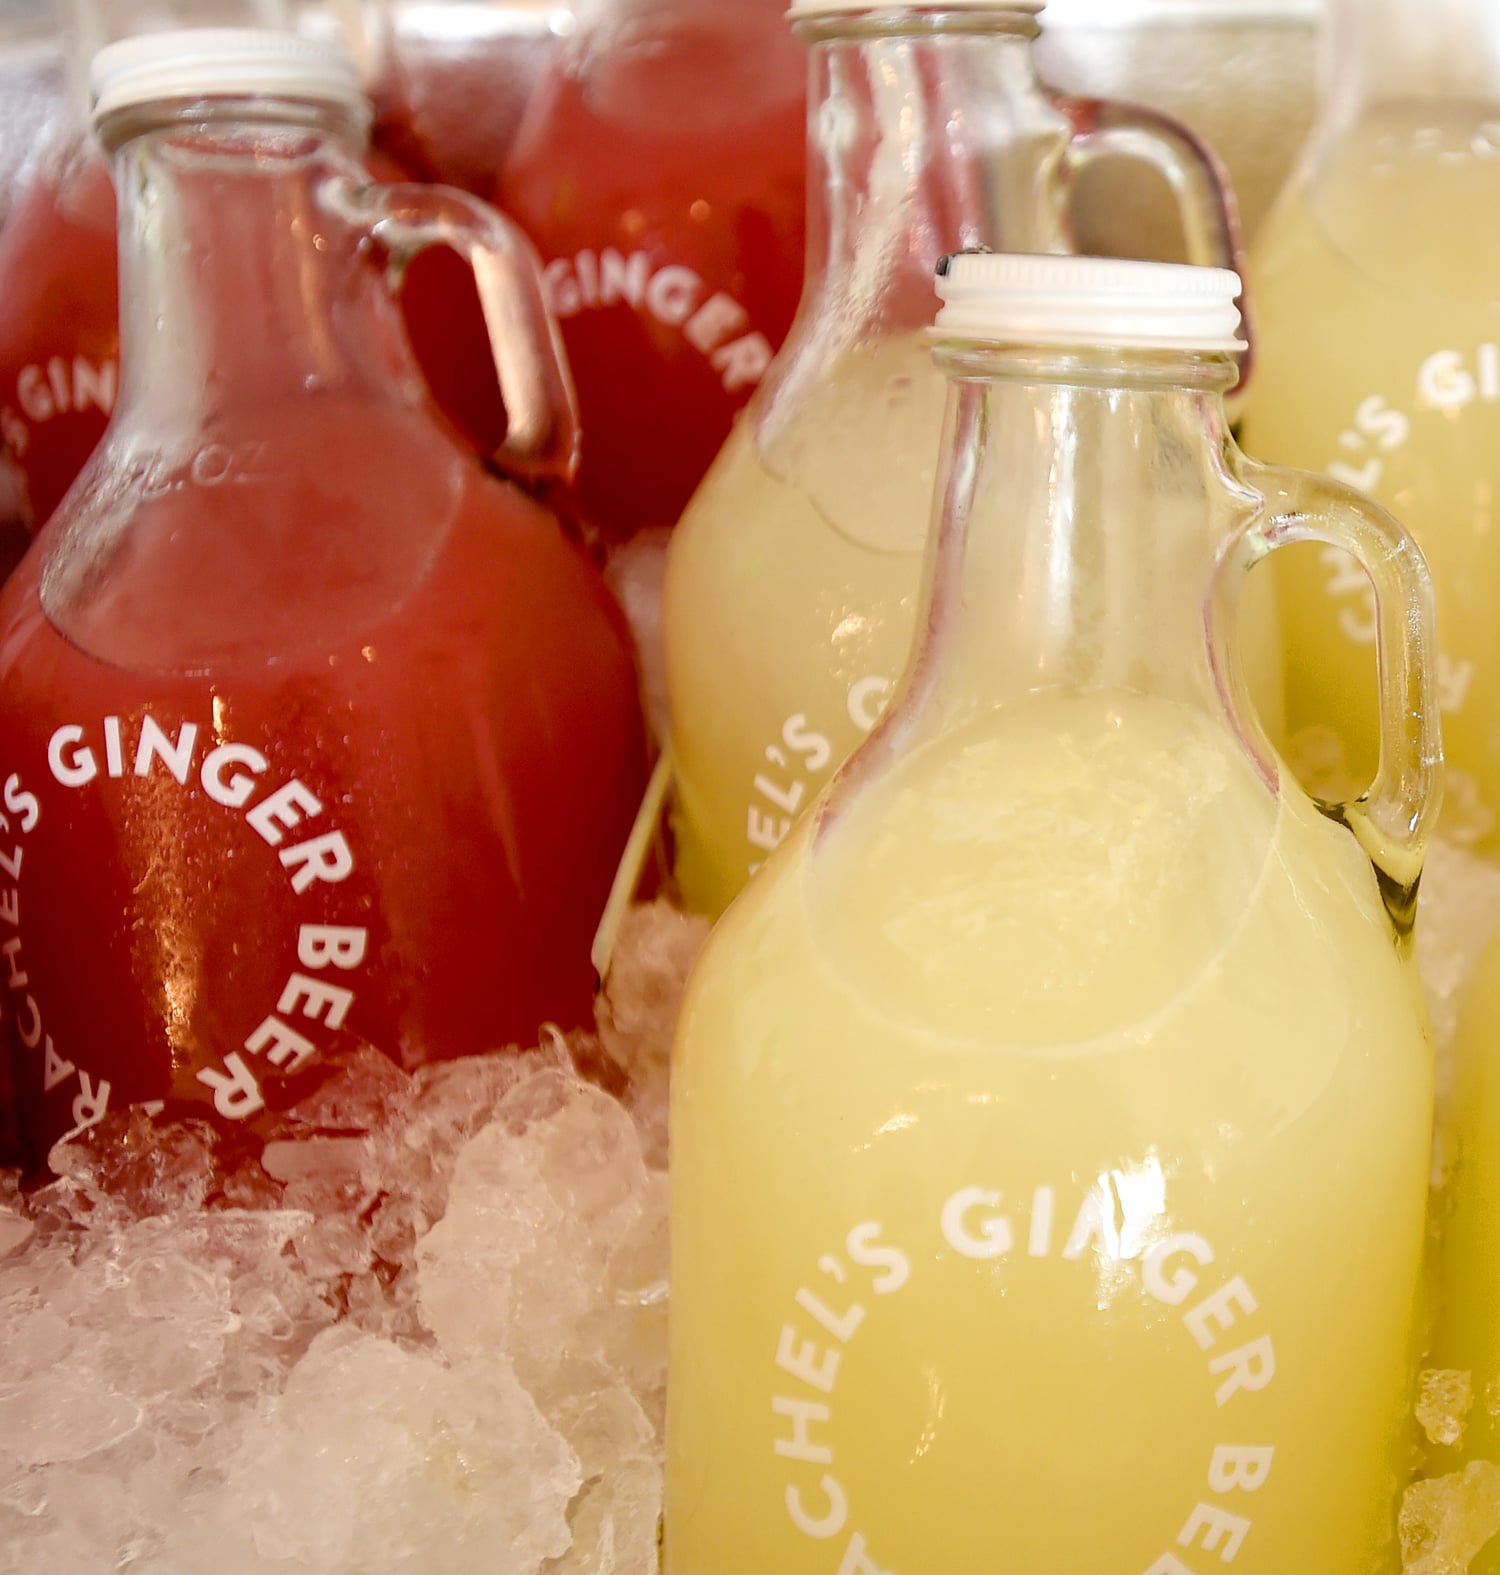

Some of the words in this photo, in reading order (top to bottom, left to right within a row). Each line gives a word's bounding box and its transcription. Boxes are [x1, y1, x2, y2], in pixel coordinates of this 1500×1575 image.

[542, 246, 776, 394] GINGER
[48, 714, 353, 895] GINGER
[196, 924, 366, 1119] BEER
[940, 1184, 1276, 1408] GINGER
